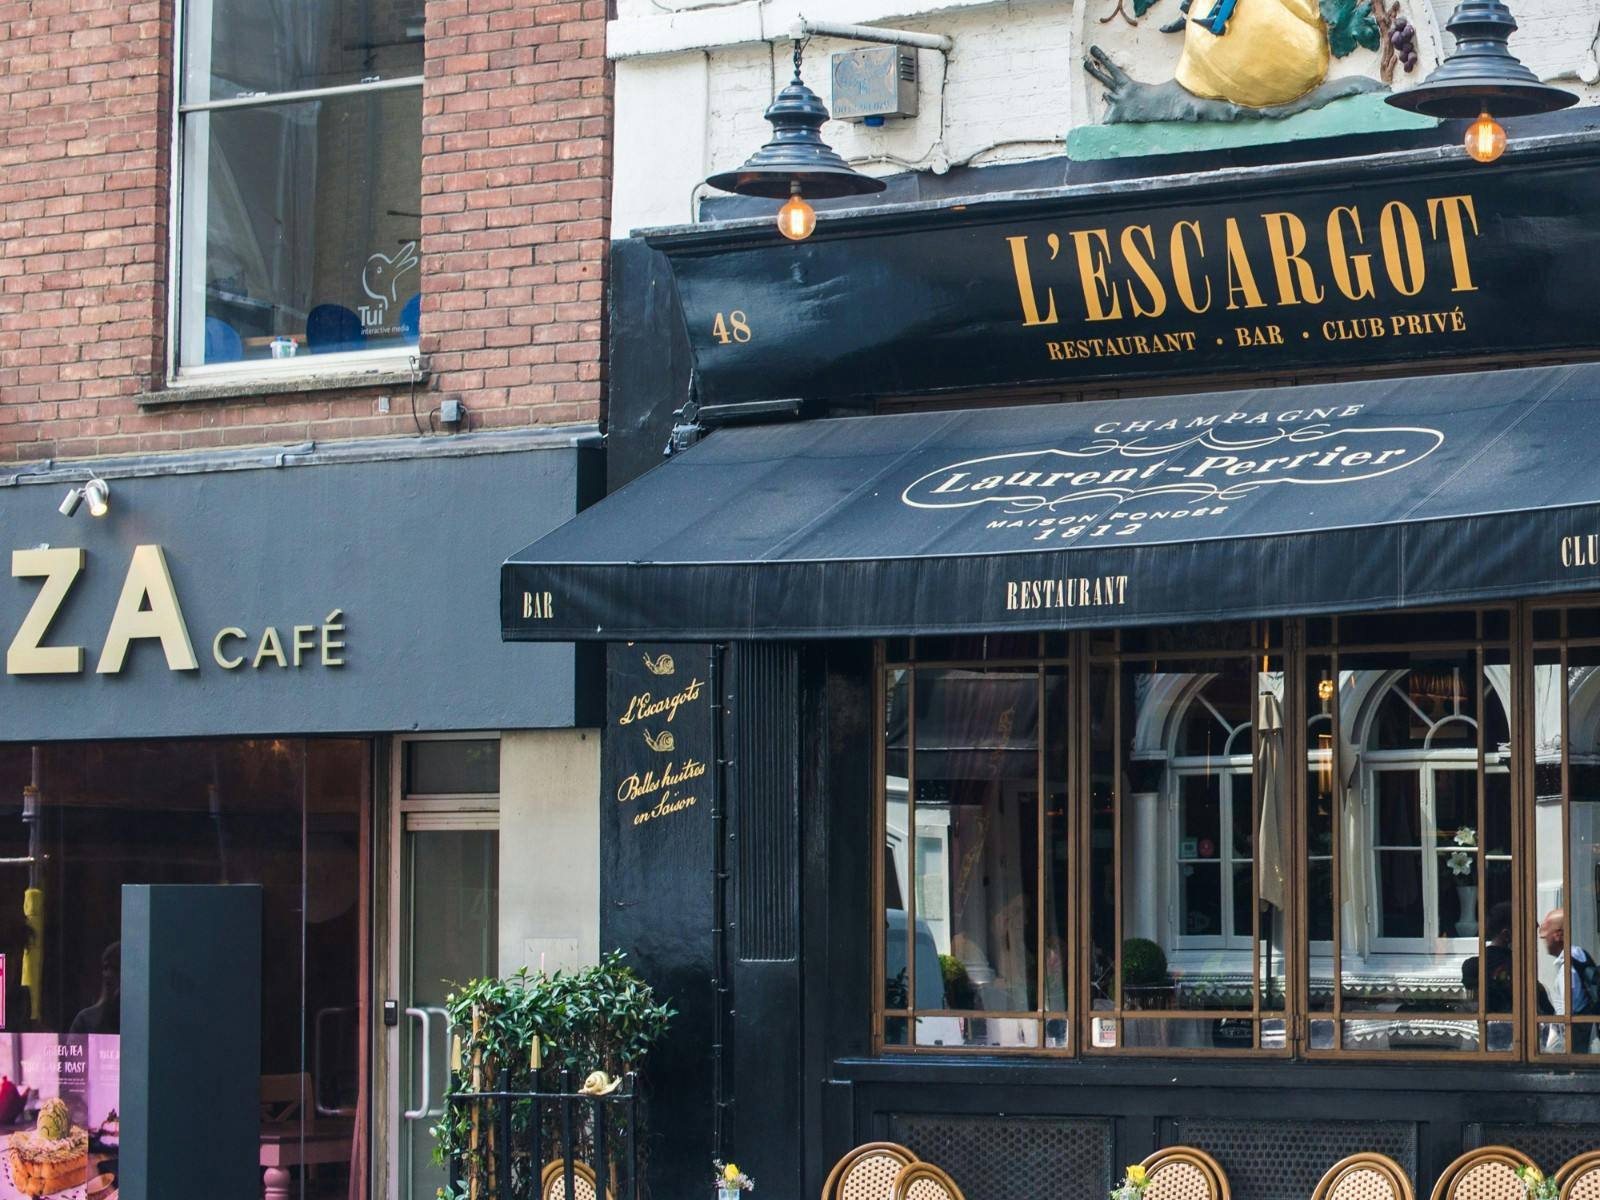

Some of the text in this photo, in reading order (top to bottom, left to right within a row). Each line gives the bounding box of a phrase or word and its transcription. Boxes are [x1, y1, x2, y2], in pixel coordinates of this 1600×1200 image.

[1006, 194, 1479, 327] L'ESCARGOT
[358, 304, 382, 326] Tui
[361, 324, 410, 335] interactive media
[713, 310, 752, 344] 48
[1047, 306, 1467, 360] RESTAURANT BAR CLUB PRIVÉ
[1094, 403, 1364, 435] CHAMPAGNE
[930, 445, 1406, 494] Laurent-Perrier
[986, 508, 1099, 529] MAISON
[1033, 522, 1143, 541] 1812
[523, 591, 554, 618] BAR
[1006, 575, 1129, 611] RESTAURANT
[212, 608, 346, 669] CAFÉ
[619, 677, 705, 725] L'Escargots
[617, 772, 660, 802] Belles
[633, 812, 651, 825] en
[43, 1044, 83, 1057] GEN TEA
[64, 1062, 86, 1073] TOAST
